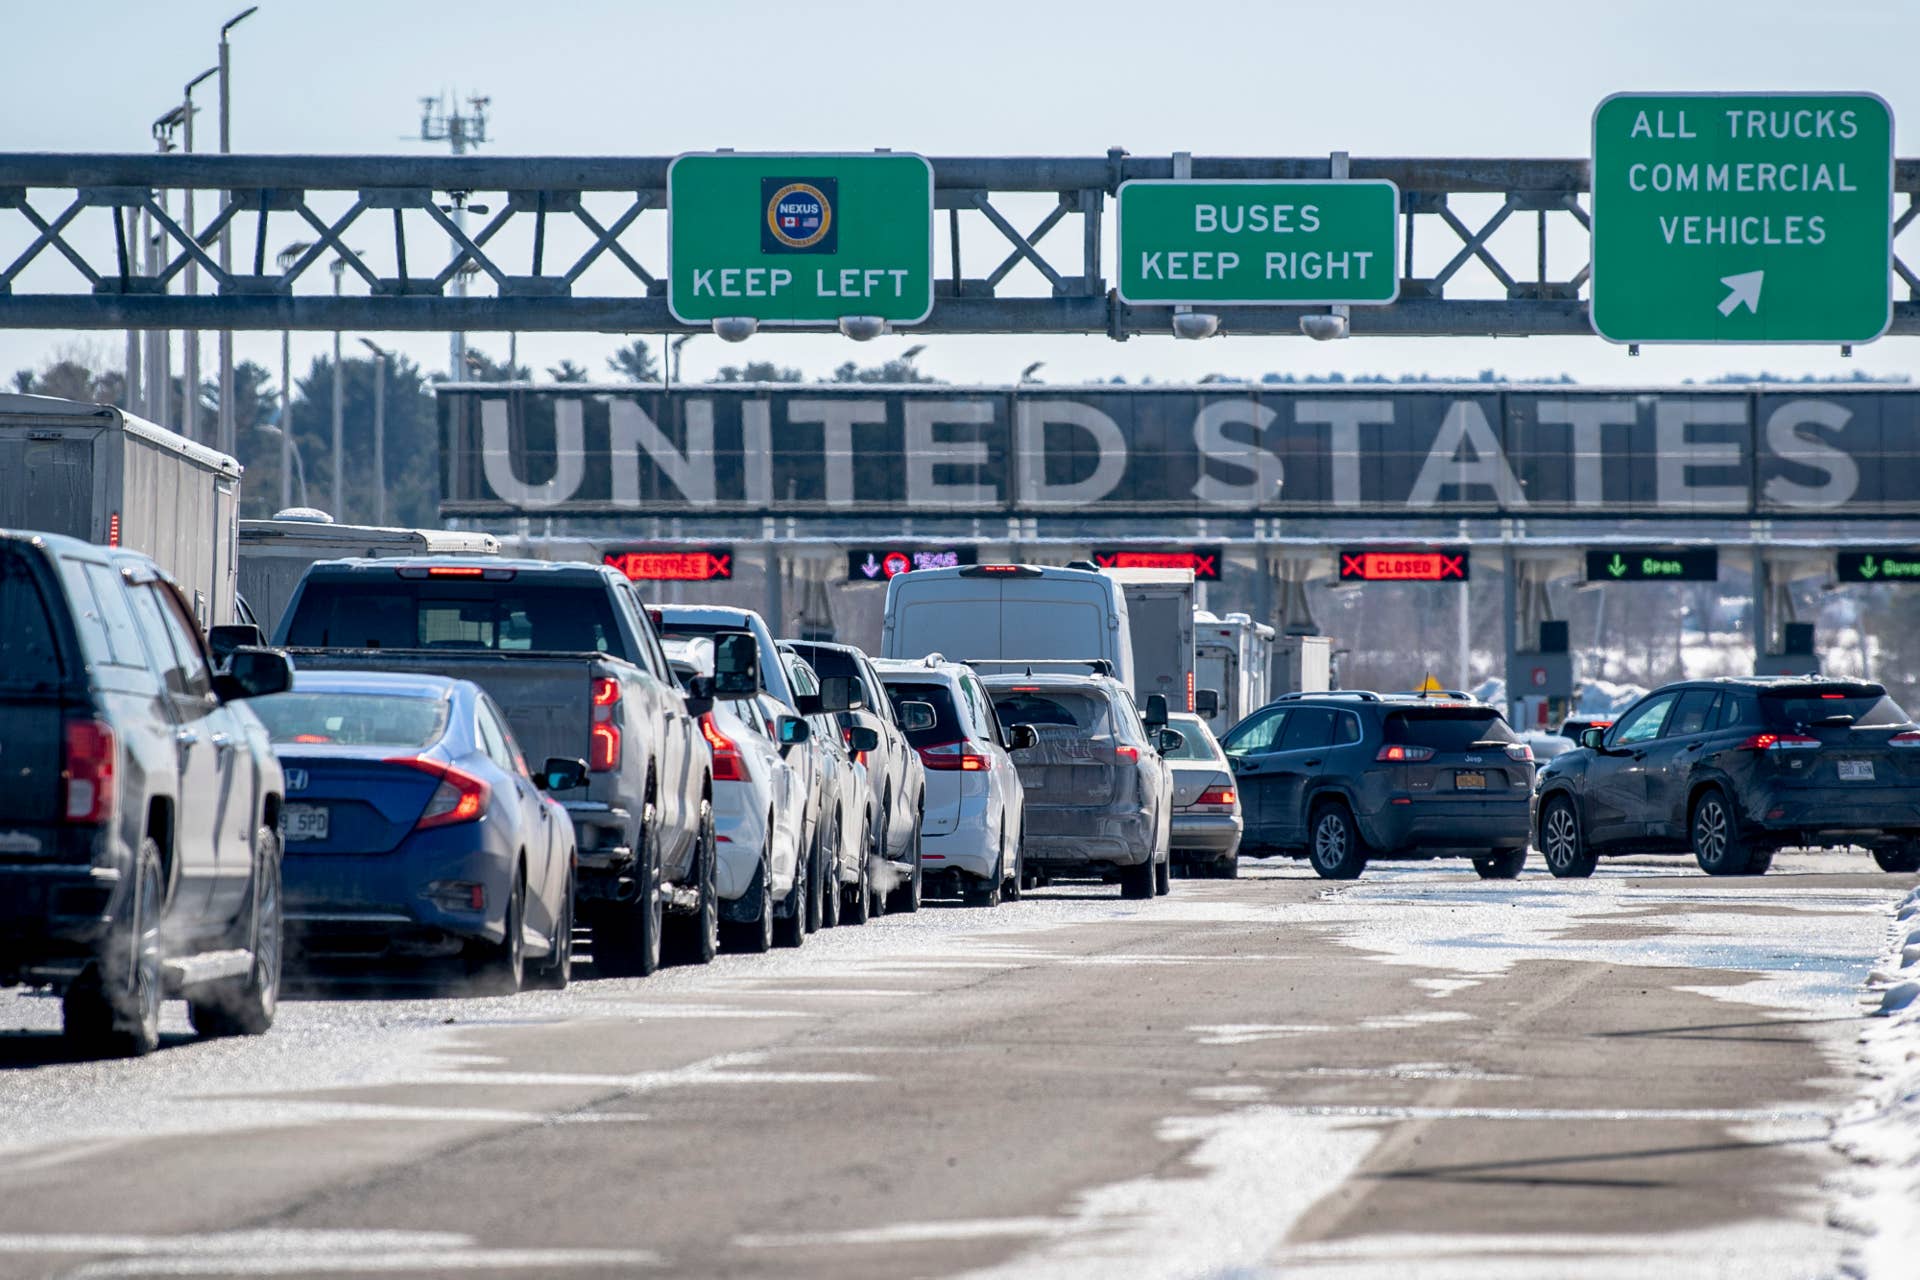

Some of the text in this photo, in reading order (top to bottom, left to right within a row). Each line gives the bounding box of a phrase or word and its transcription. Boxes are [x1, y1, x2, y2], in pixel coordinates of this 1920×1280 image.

[1631, 110, 1857, 139] ALL TRUCKS
[1629, 163, 1857, 192] COMMERCIAL
[780, 203, 819, 214] NEXUS
[1195, 204, 1320, 233] BUSES
[1659, 216, 1826, 245] VEHICLES
[1142, 251, 1373, 280] KEEP RIGHT
[693, 268, 908, 297] KEEP LEFT
[481, 399, 1859, 508] UNITED STATES
[1376, 560, 1432, 574] CLOSED
[1464, 754, 1483, 763] Jeep
